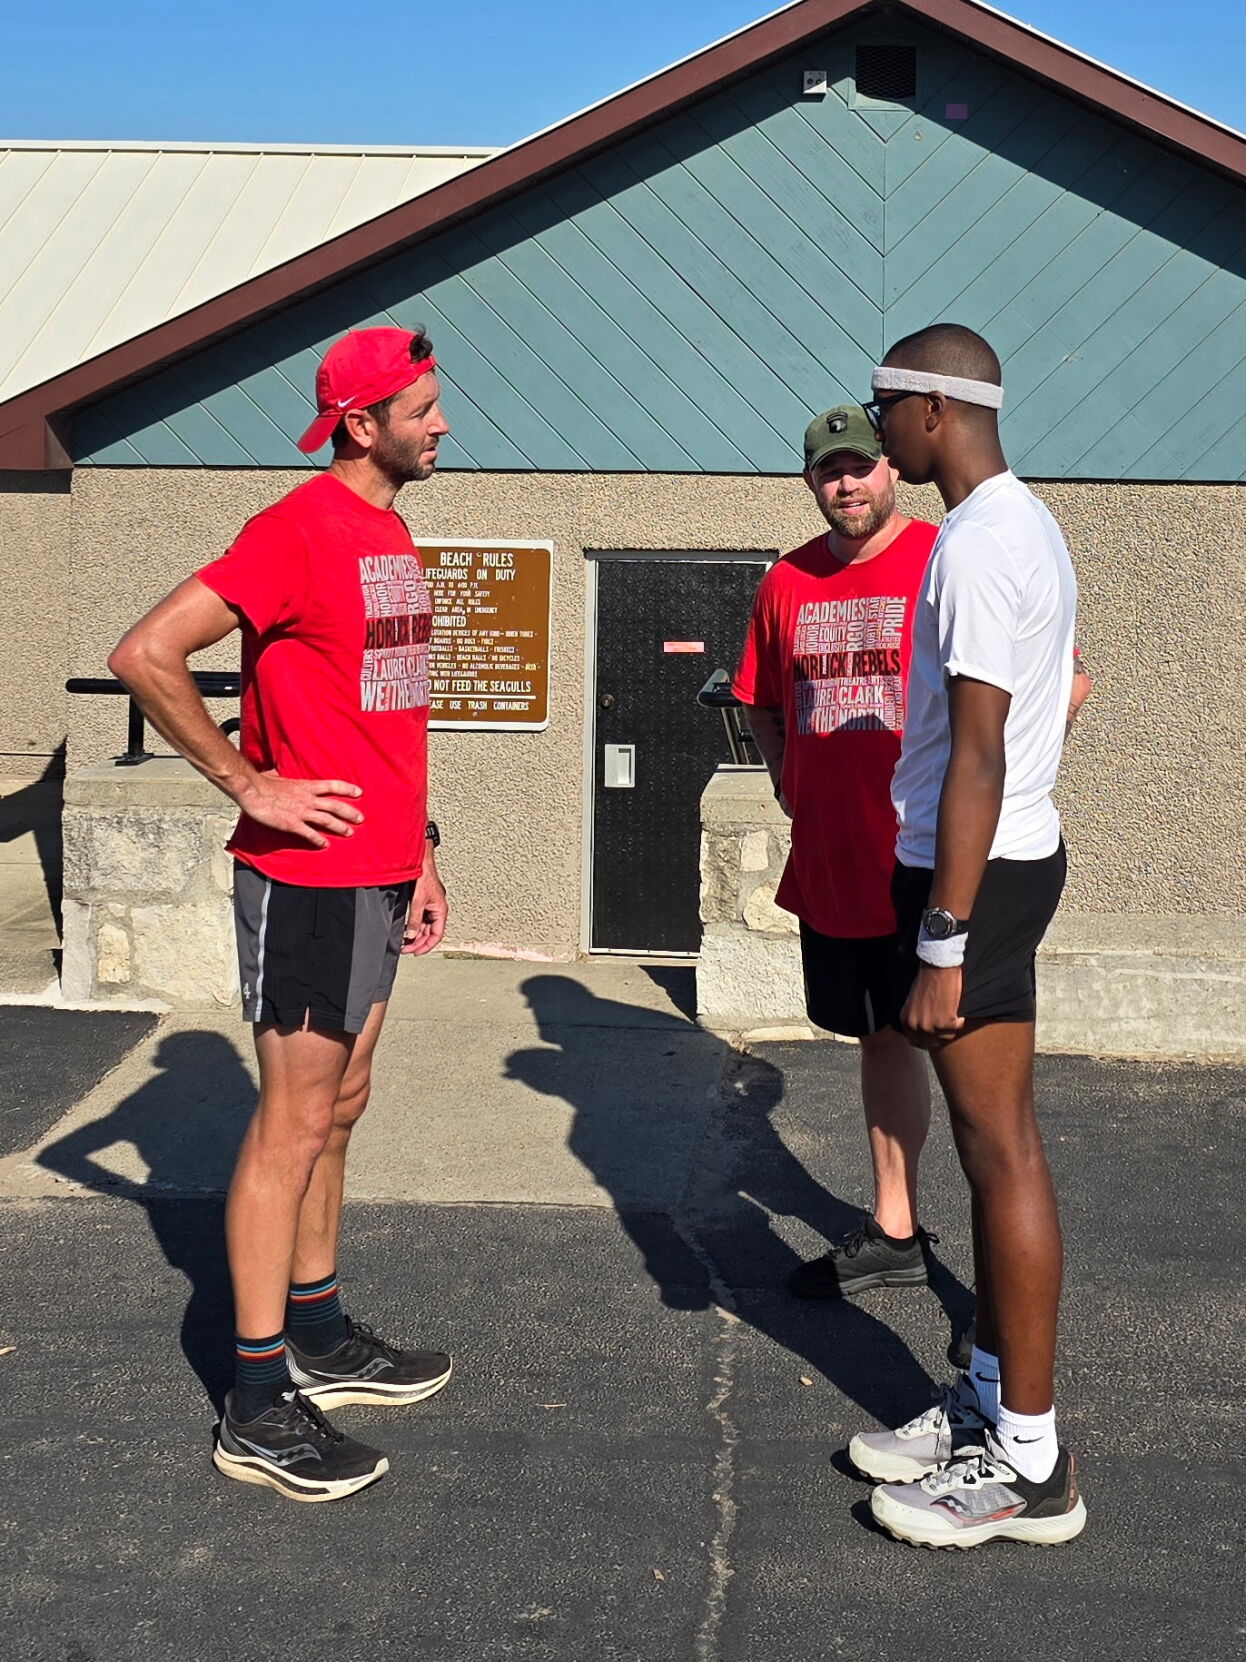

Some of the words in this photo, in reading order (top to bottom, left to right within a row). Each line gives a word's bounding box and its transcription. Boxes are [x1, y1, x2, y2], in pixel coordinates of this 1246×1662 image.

[359, 555, 413, 584] ACADEMIES
[440, 552, 472, 566] BEACH
[483, 552, 513, 567] RULES
[476, 569, 488, 580] ON
[496, 569, 516, 580] DUTY
[375, 582, 392, 617] HONOR
[796, 597, 866, 626] ACADEMIES
[431, 615, 467, 628] OHIBITED
[881, 596, 906, 637] PRIDE
[805, 624, 820, 653] HONOR
[793, 651, 848, 681] HORLICK
[852, 648, 902, 677] REBELS
[433, 680, 450, 691] NOT
[452, 680, 471, 692] FEED
[473, 680, 488, 692] THE
[490, 681, 531, 693] SEAGULLS
[839, 685, 884, 705] CLARK
[449, 700, 462, 710] USE
[468, 700, 488, 710] TRASH
[493, 701, 530, 711] CONTAINERS
[813, 706, 836, 733] THE
